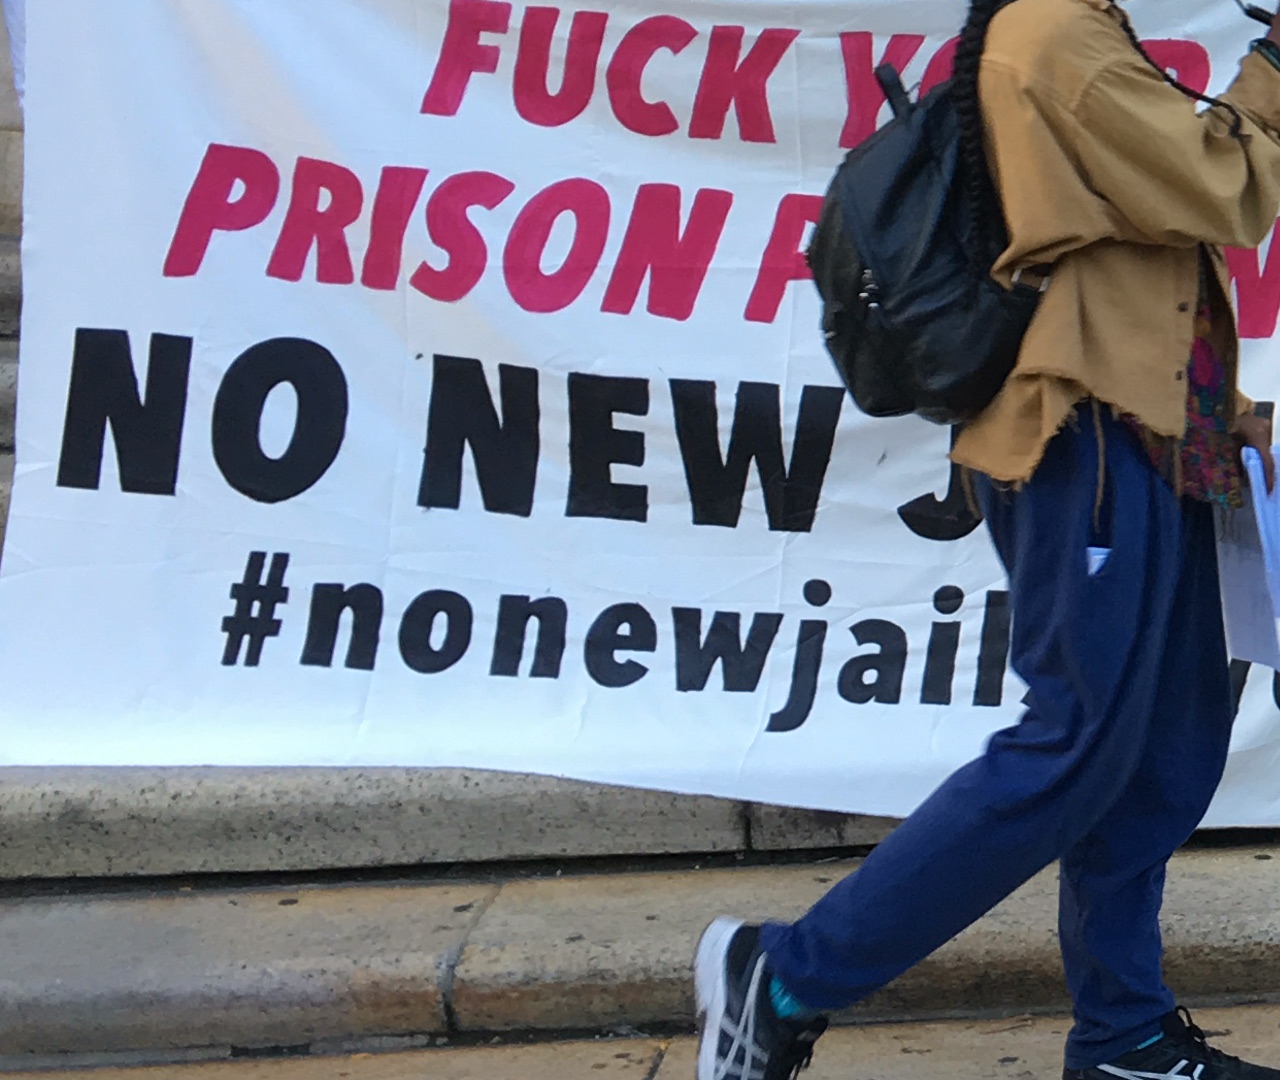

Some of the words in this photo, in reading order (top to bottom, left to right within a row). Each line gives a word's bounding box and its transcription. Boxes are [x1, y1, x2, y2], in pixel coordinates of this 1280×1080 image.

[163, 143, 734, 321] PRISON
[56, 327, 348, 504] NO
[417, 353, 846, 533] NEW
